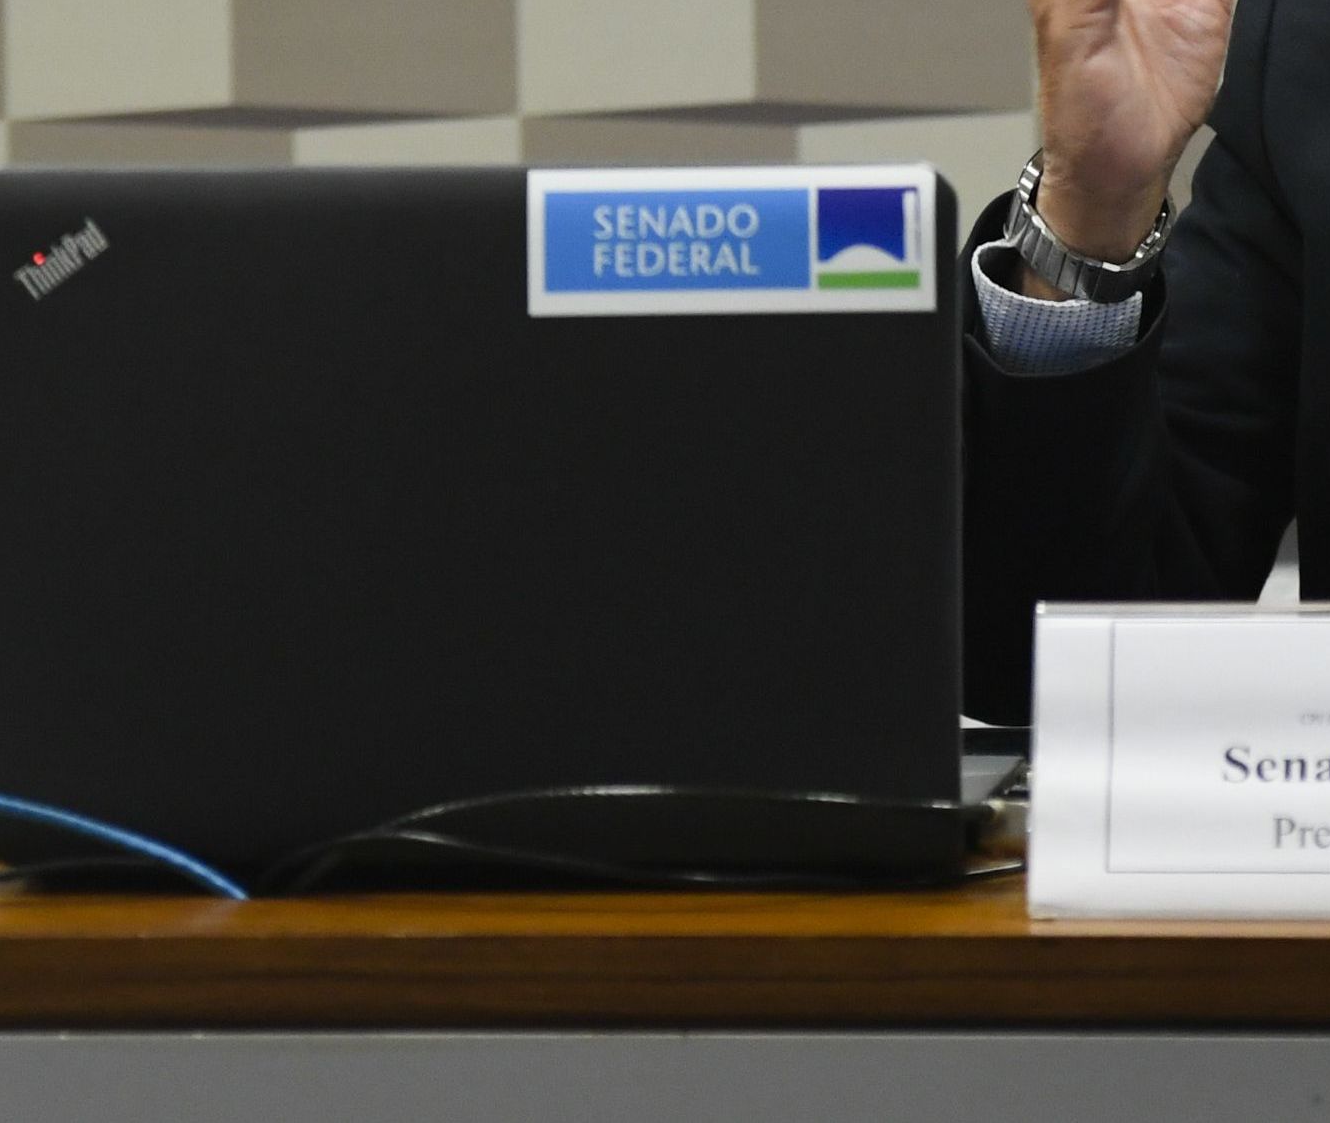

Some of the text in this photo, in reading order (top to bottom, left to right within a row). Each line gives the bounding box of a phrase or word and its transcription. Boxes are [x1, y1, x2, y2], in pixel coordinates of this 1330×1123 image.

[593, 204, 759, 240] SENADO
[13, 217, 109, 301] ThinkPad
[593, 241, 760, 277] FEDERAL
